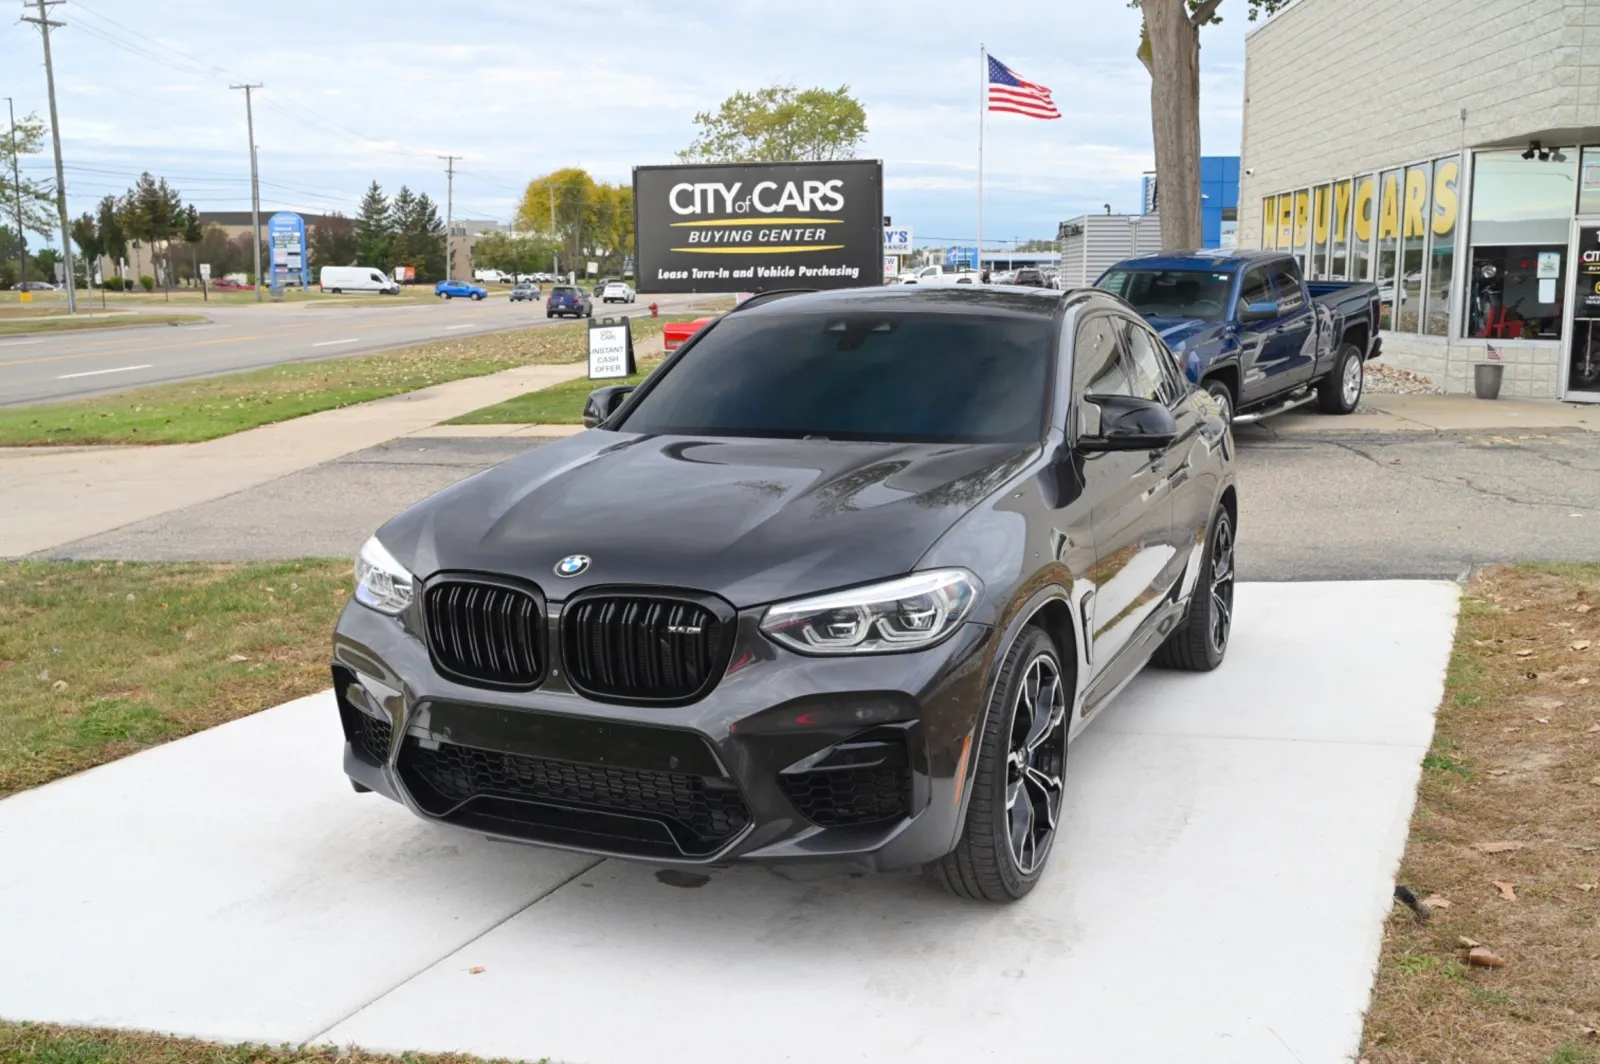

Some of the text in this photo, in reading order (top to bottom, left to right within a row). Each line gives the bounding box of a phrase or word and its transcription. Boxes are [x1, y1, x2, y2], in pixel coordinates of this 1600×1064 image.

[669, 180, 845, 216] CITY of CARS
[1263, 161, 1460, 249] WE BUY CARS
[688, 228, 827, 244] BUYING CENTER
[657, 264, 860, 281] Lease Turn-In and Vehicle Purchasing
[592, 346, 624, 355] INSTANT
[597, 355, 619, 364] CASH
[595, 364, 621, 373] OFFER
